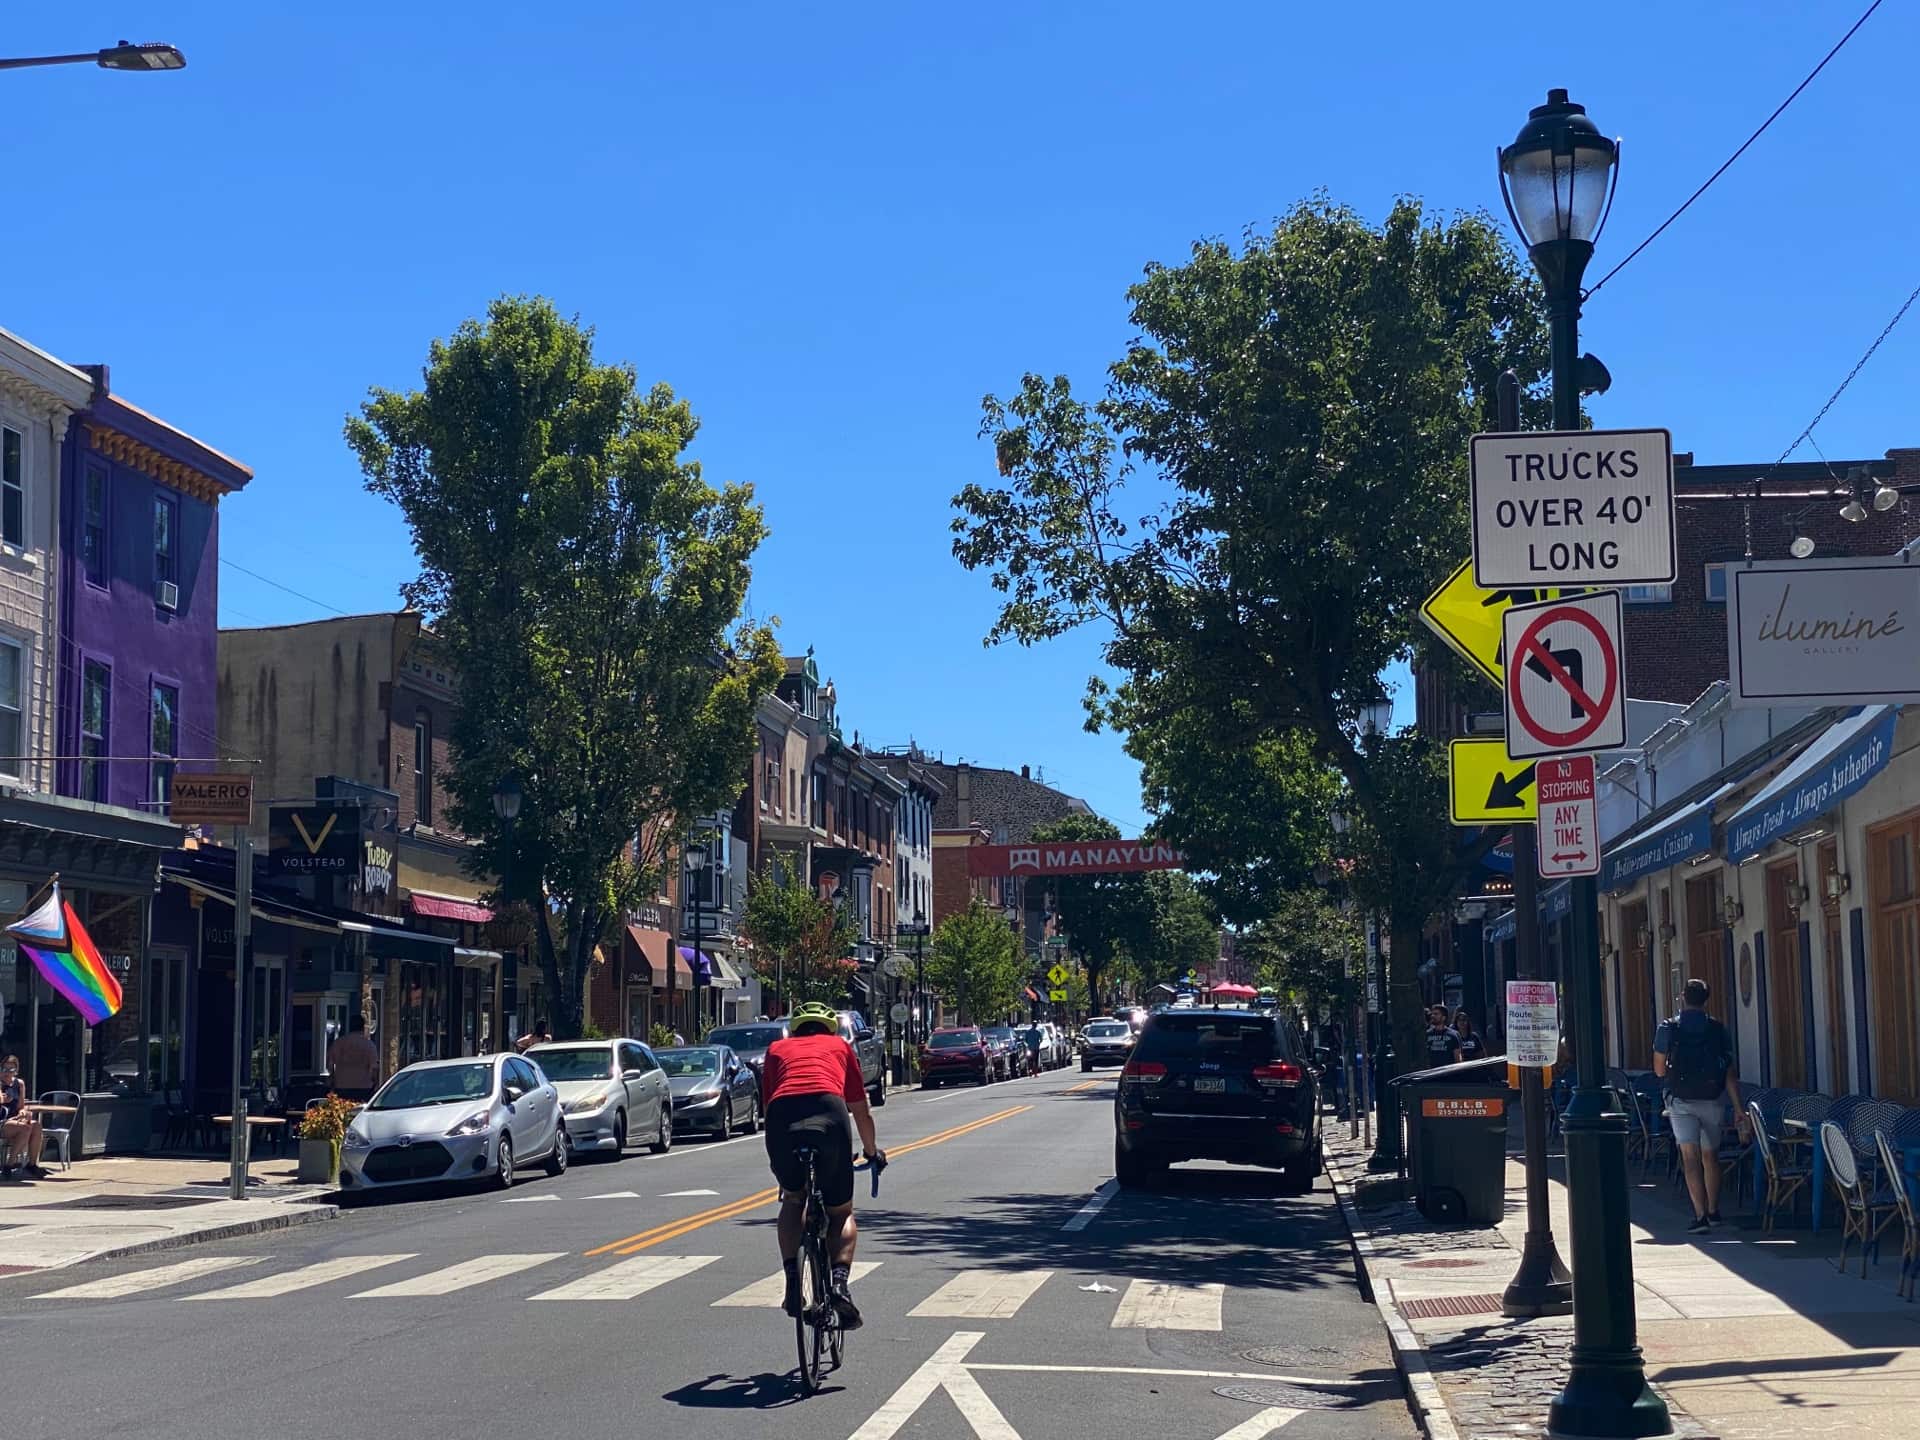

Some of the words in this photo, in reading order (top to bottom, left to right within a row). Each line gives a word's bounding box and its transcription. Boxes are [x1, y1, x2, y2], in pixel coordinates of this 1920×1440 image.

[1505, 450, 1639, 482] TRUCKS
[1496, 498, 1584, 528] OVER
[1596, 496, 1651, 525] 40'
[1528, 541, 1619, 571] LONG
[1758, 584, 1904, 641] iluminé
[1557, 762, 1572, 778] NO
[175, 784, 249, 798] VALERIO
[1542, 779, 1590, 799] STOPPING
[1734, 822, 1761, 854] Always
[1762, 801, 1785, 838] Fresh
[1792, 781, 1828, 819] Always
[1829, 736, 1883, 797] Authentic
[1554, 805, 1580, 825] ANY
[1554, 827, 1583, 847] TIME
[1663, 831, 1694, 859] Cuisine
[282, 858, 345, 867] VOLSTEAD
[365, 866, 392, 895] ROBOT
[1511, 985, 1552, 994] TEMPORARY
[1518, 995, 1547, 1003] DETOUR
[1509, 1010, 1532, 1018] Route
[1200, 1062, 1220, 1071] Jeep
